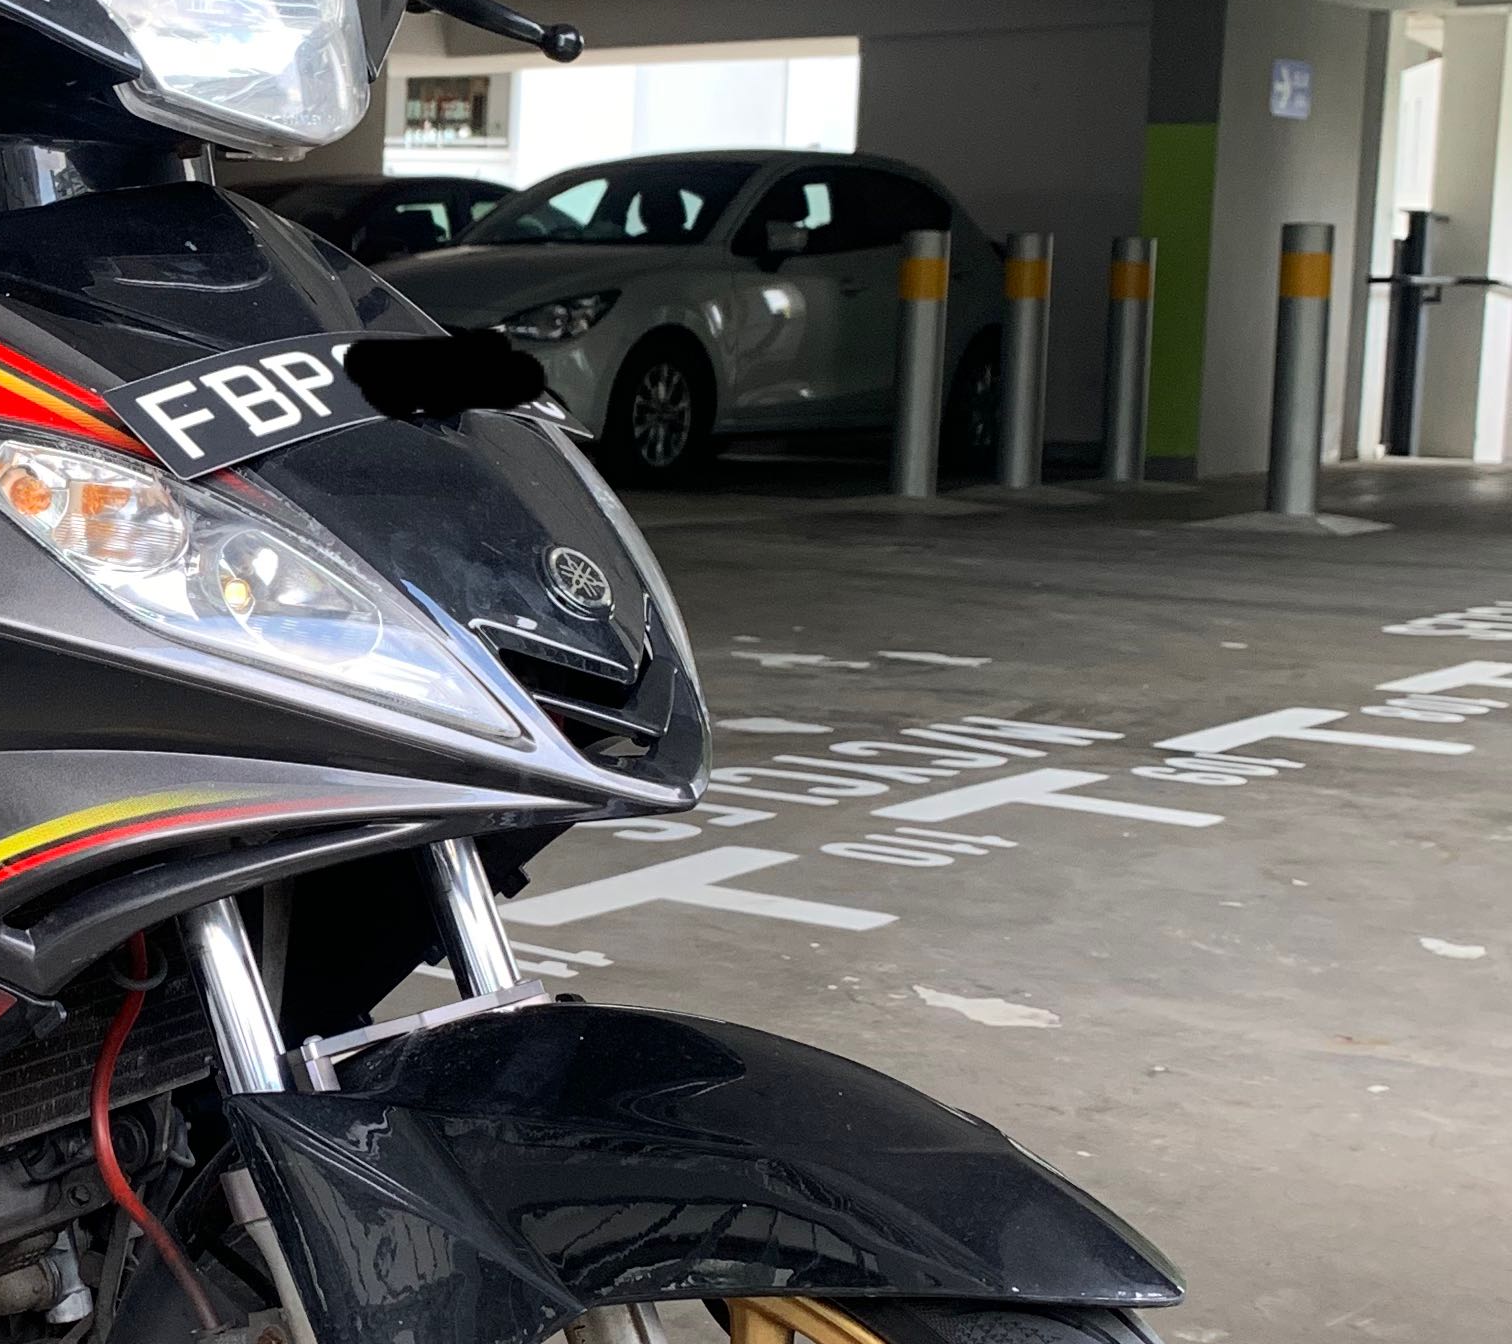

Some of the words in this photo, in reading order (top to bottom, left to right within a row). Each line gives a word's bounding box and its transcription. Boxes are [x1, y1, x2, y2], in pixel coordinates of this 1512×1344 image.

[1360, 693, 1507, 723] 108
[1130, 752, 1306, 787] 109
[820, 826, 1018, 867] 110
